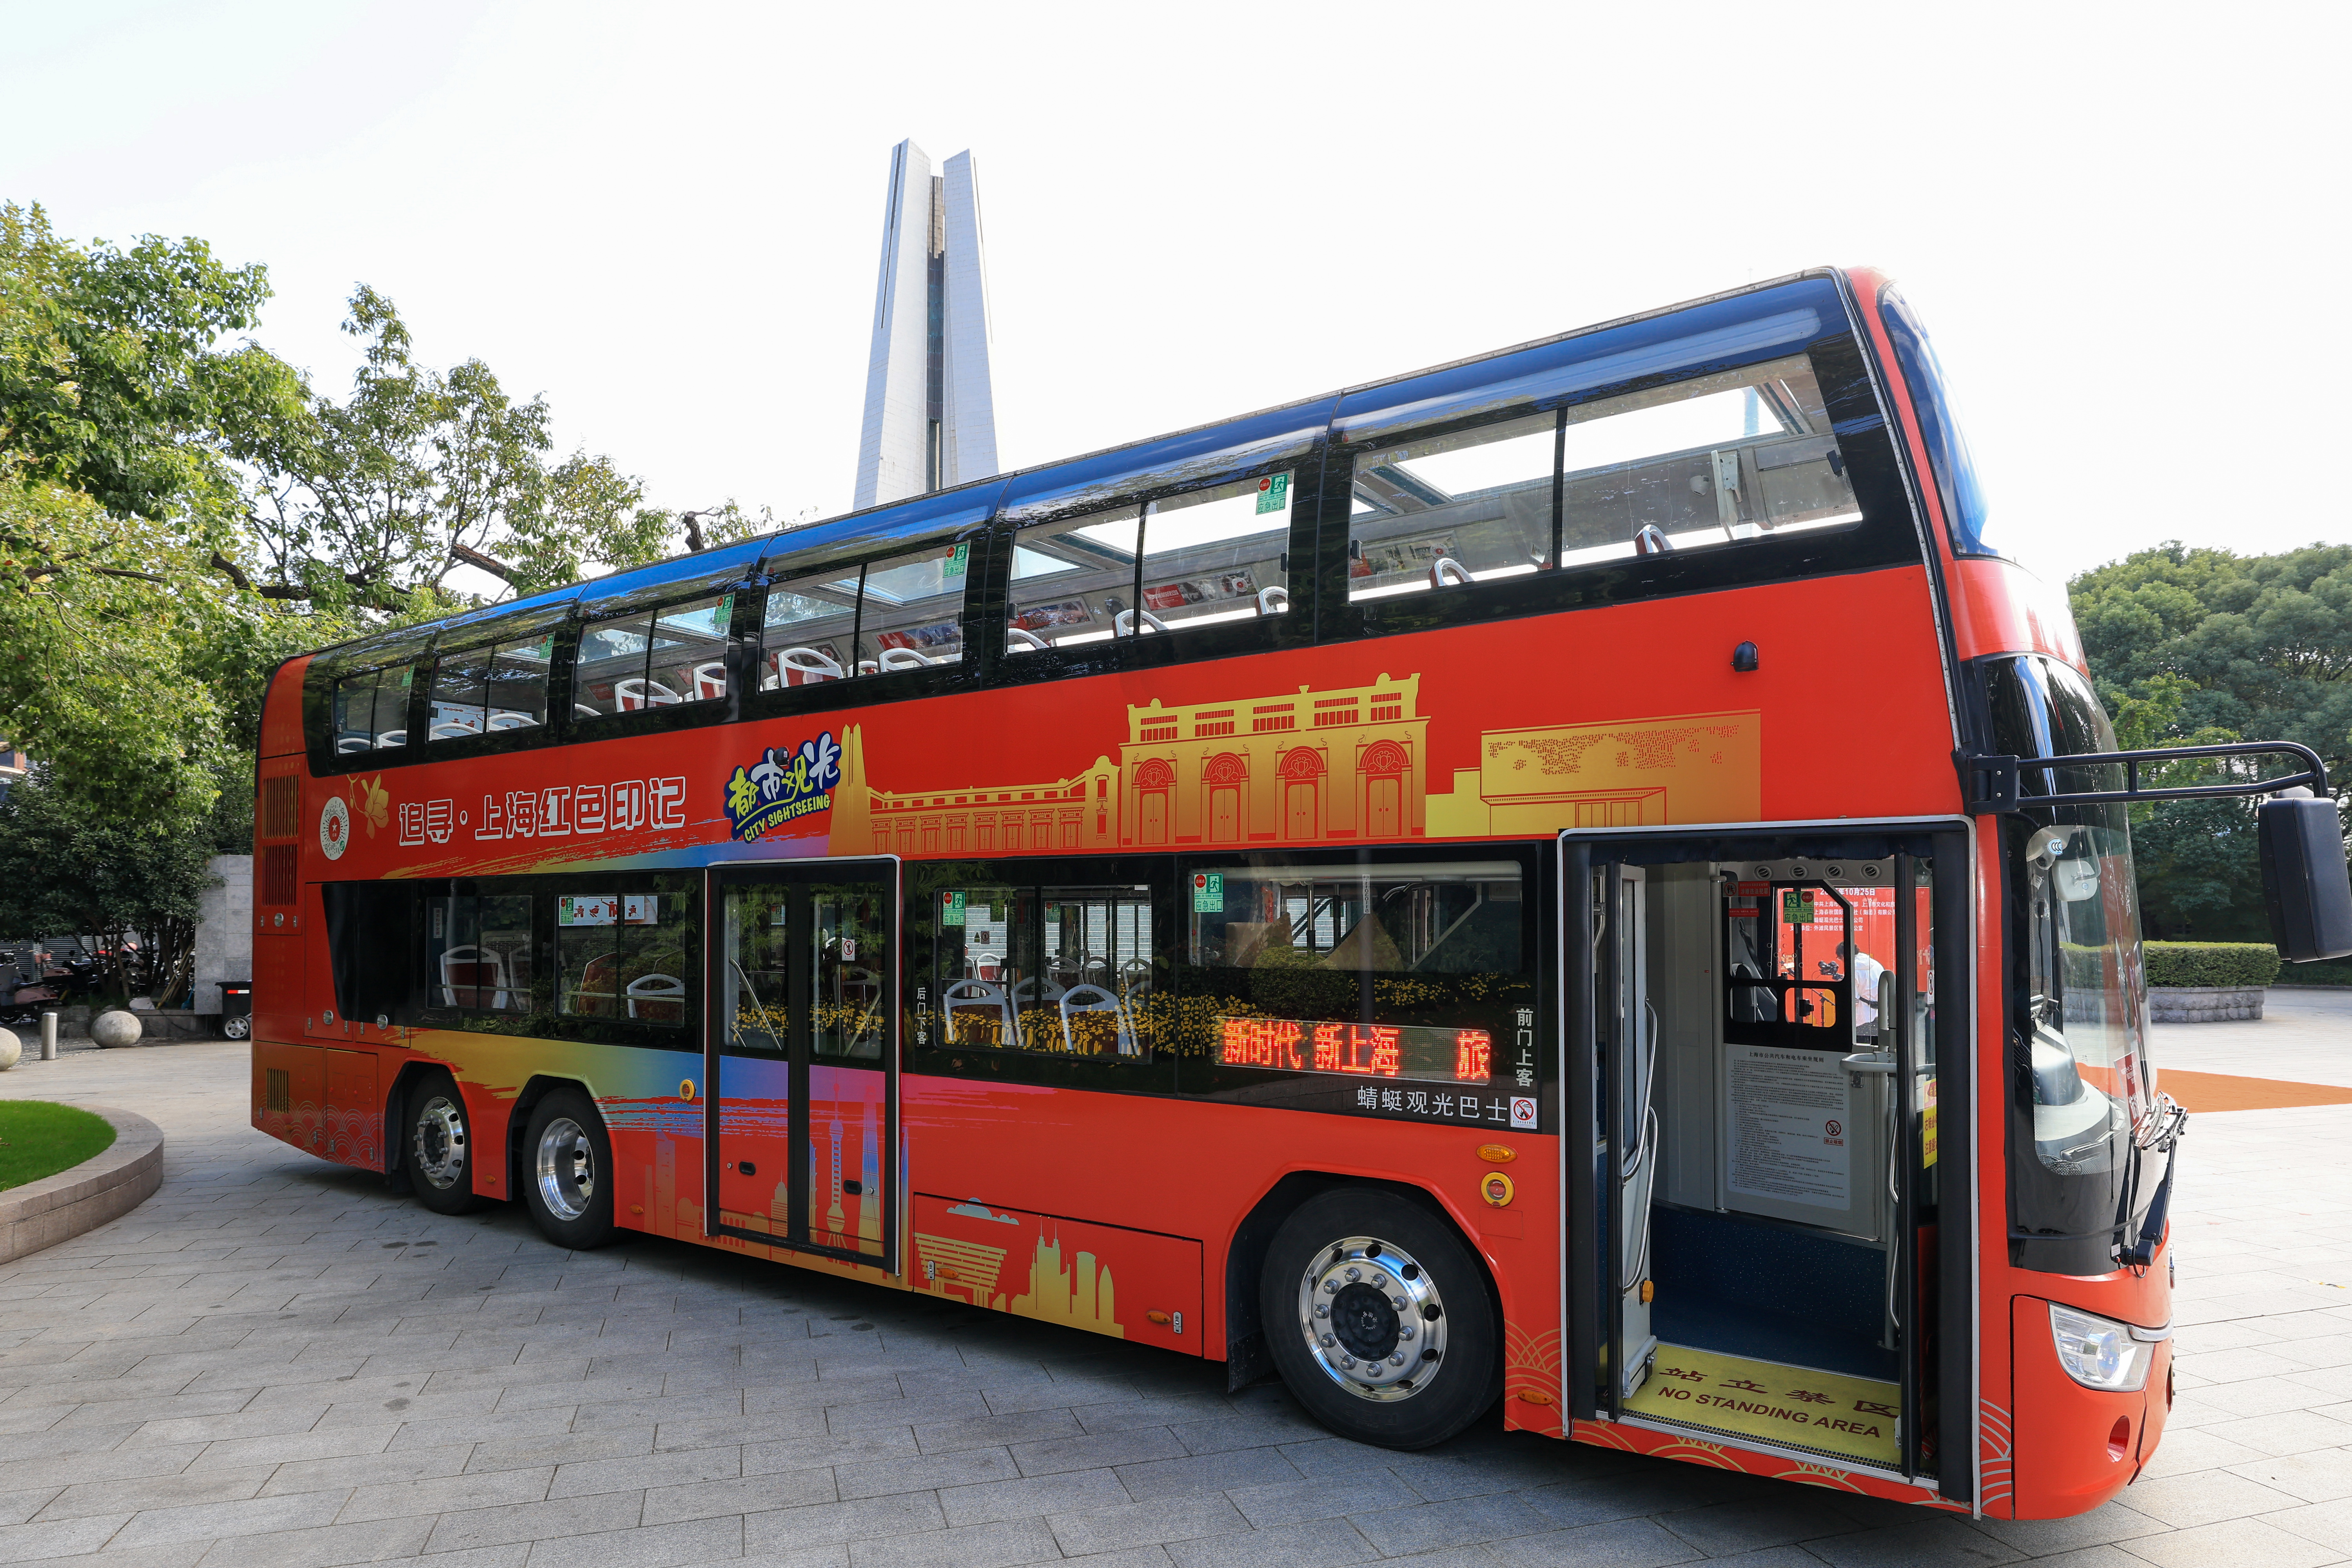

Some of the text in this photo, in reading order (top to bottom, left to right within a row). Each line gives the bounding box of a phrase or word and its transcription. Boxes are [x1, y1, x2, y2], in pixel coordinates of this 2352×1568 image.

[1258, 498, 1285, 513] 应急出口
[944, 564, 965, 576] 应急出口
[727, 732, 840, 819] 都市观光
[399, 776, 686, 846] 追寻·上海红色印记
[744, 793, 831, 842] CITY SIGHTSEEING
[944, 915, 964, 924] 应急出口
[1196, 900, 1222, 911] 应急出口
[1784, 913, 1813, 922] 应急出口
[916, 987, 927, 1045] 后门下客
[1224, 1020, 1490, 1080] 新时代 新上海 旅
[1515, 1007, 1534, 1087] 前门上客
[1748, 1051, 1824, 1063] 上海市公共汽车和电车乘坐规则
[1357, 1085, 1508, 1122] 蜻蜓观光巴士
[1658, 1387, 1881, 1439] NO STANDING AREA
[1659, 1367, 1901, 1419] 站立禁区
